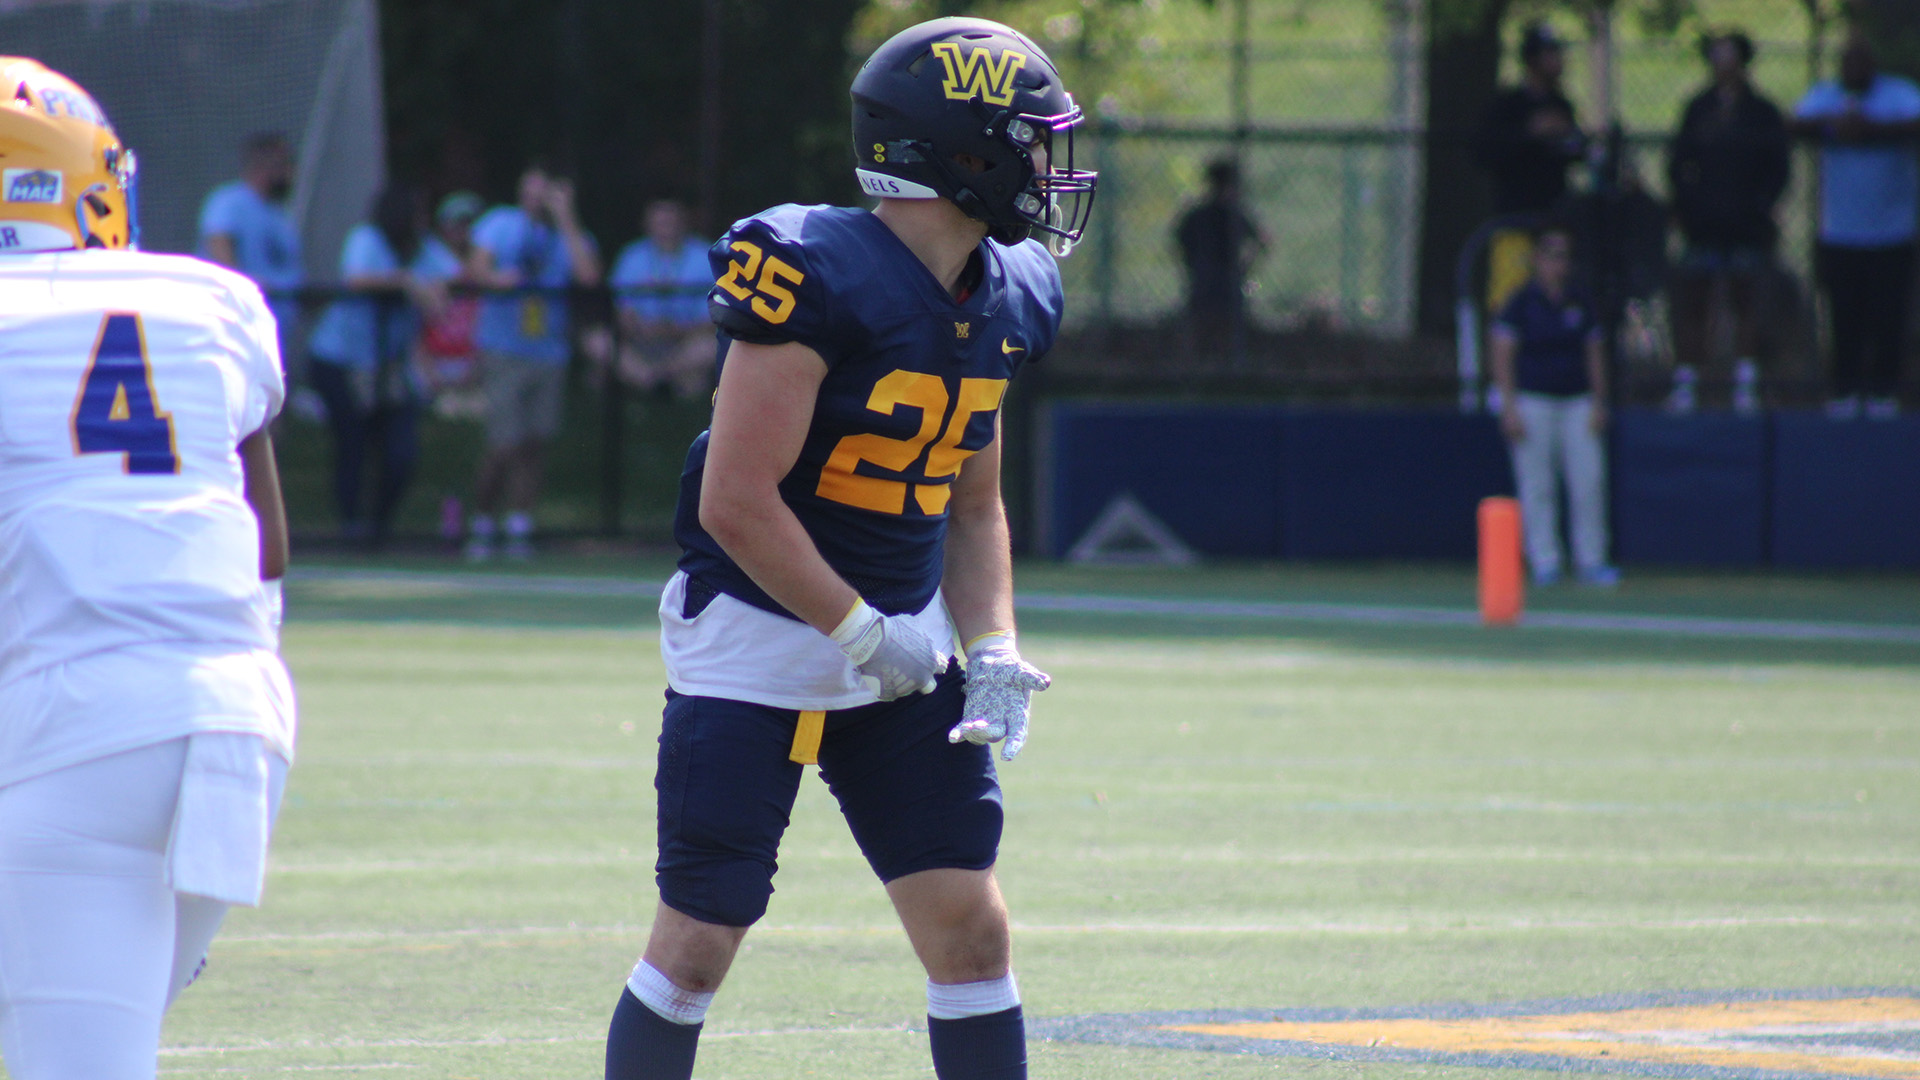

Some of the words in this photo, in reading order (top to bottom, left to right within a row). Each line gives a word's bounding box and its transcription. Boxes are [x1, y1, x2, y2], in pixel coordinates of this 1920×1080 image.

[931, 42, 1026, 107] W
[10, 185, 56, 201] MAC
[0, 226, 20, 247] R
[715, 240, 805, 325] 25
[68, 309, 182, 476] 4
[814, 368, 1008, 516] 25
